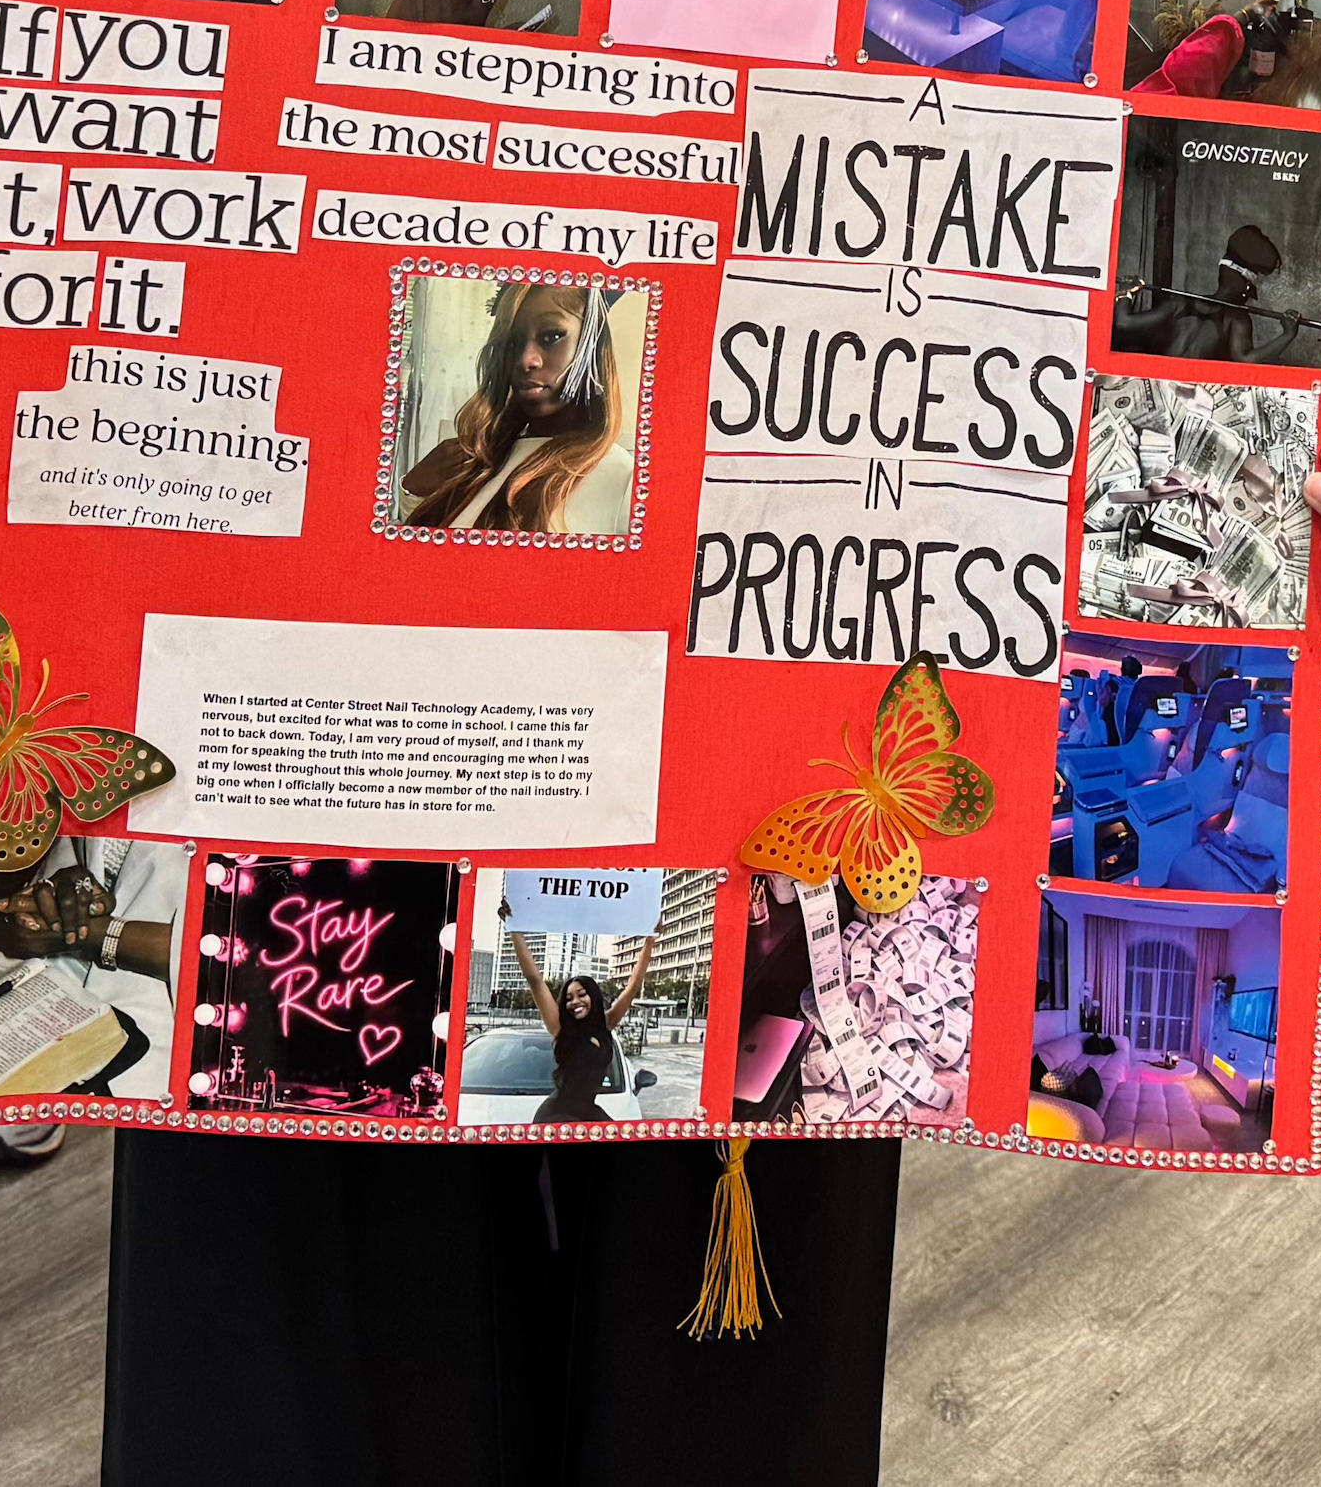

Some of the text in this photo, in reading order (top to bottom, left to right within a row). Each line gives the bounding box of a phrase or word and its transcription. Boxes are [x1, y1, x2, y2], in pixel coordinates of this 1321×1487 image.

[64, 10, 225, 80] you
[321, 27, 736, 109] I am stepping into
[908, 77, 946, 126] A
[282, 105, 741, 185] the most successful
[1181, 140, 1309, 170] CONSISTENCY
[69, 174, 296, 251] work
[318, 198, 717, 266] decade of my life
[737, 130, 1114, 279] MISTAKE
[99, 259, 179, 334] it.
[884, 267, 924, 318] IS
[71, 347, 274, 403] this is just
[708, 320, 1078, 470] SUCCESS
[16, 405, 309, 473] the beginning.
[39, 467, 274, 506] and it's only going to get
[68, 500, 235, 534] better from here.
[864, 457, 905, 511] IN
[686, 531, 1063, 679] PROGRESS
[203, 693, 236, 706] When
[247, 695, 288, 707] started
[291, 698, 303, 708] at
[305, 698, 345, 710] Center
[348, 700, 383, 711] Street
[386, 701, 408, 712] Nail
[411, 702, 477, 716] Technology
[480, 704, 536, 717] Academy,
[545, 706, 567, 715] was
[571, 708, 594, 718] very
[539, 876, 631, 900] THE TOP
[259, 896, 395, 974] Stay
[269, 965, 414, 1038] Rare
